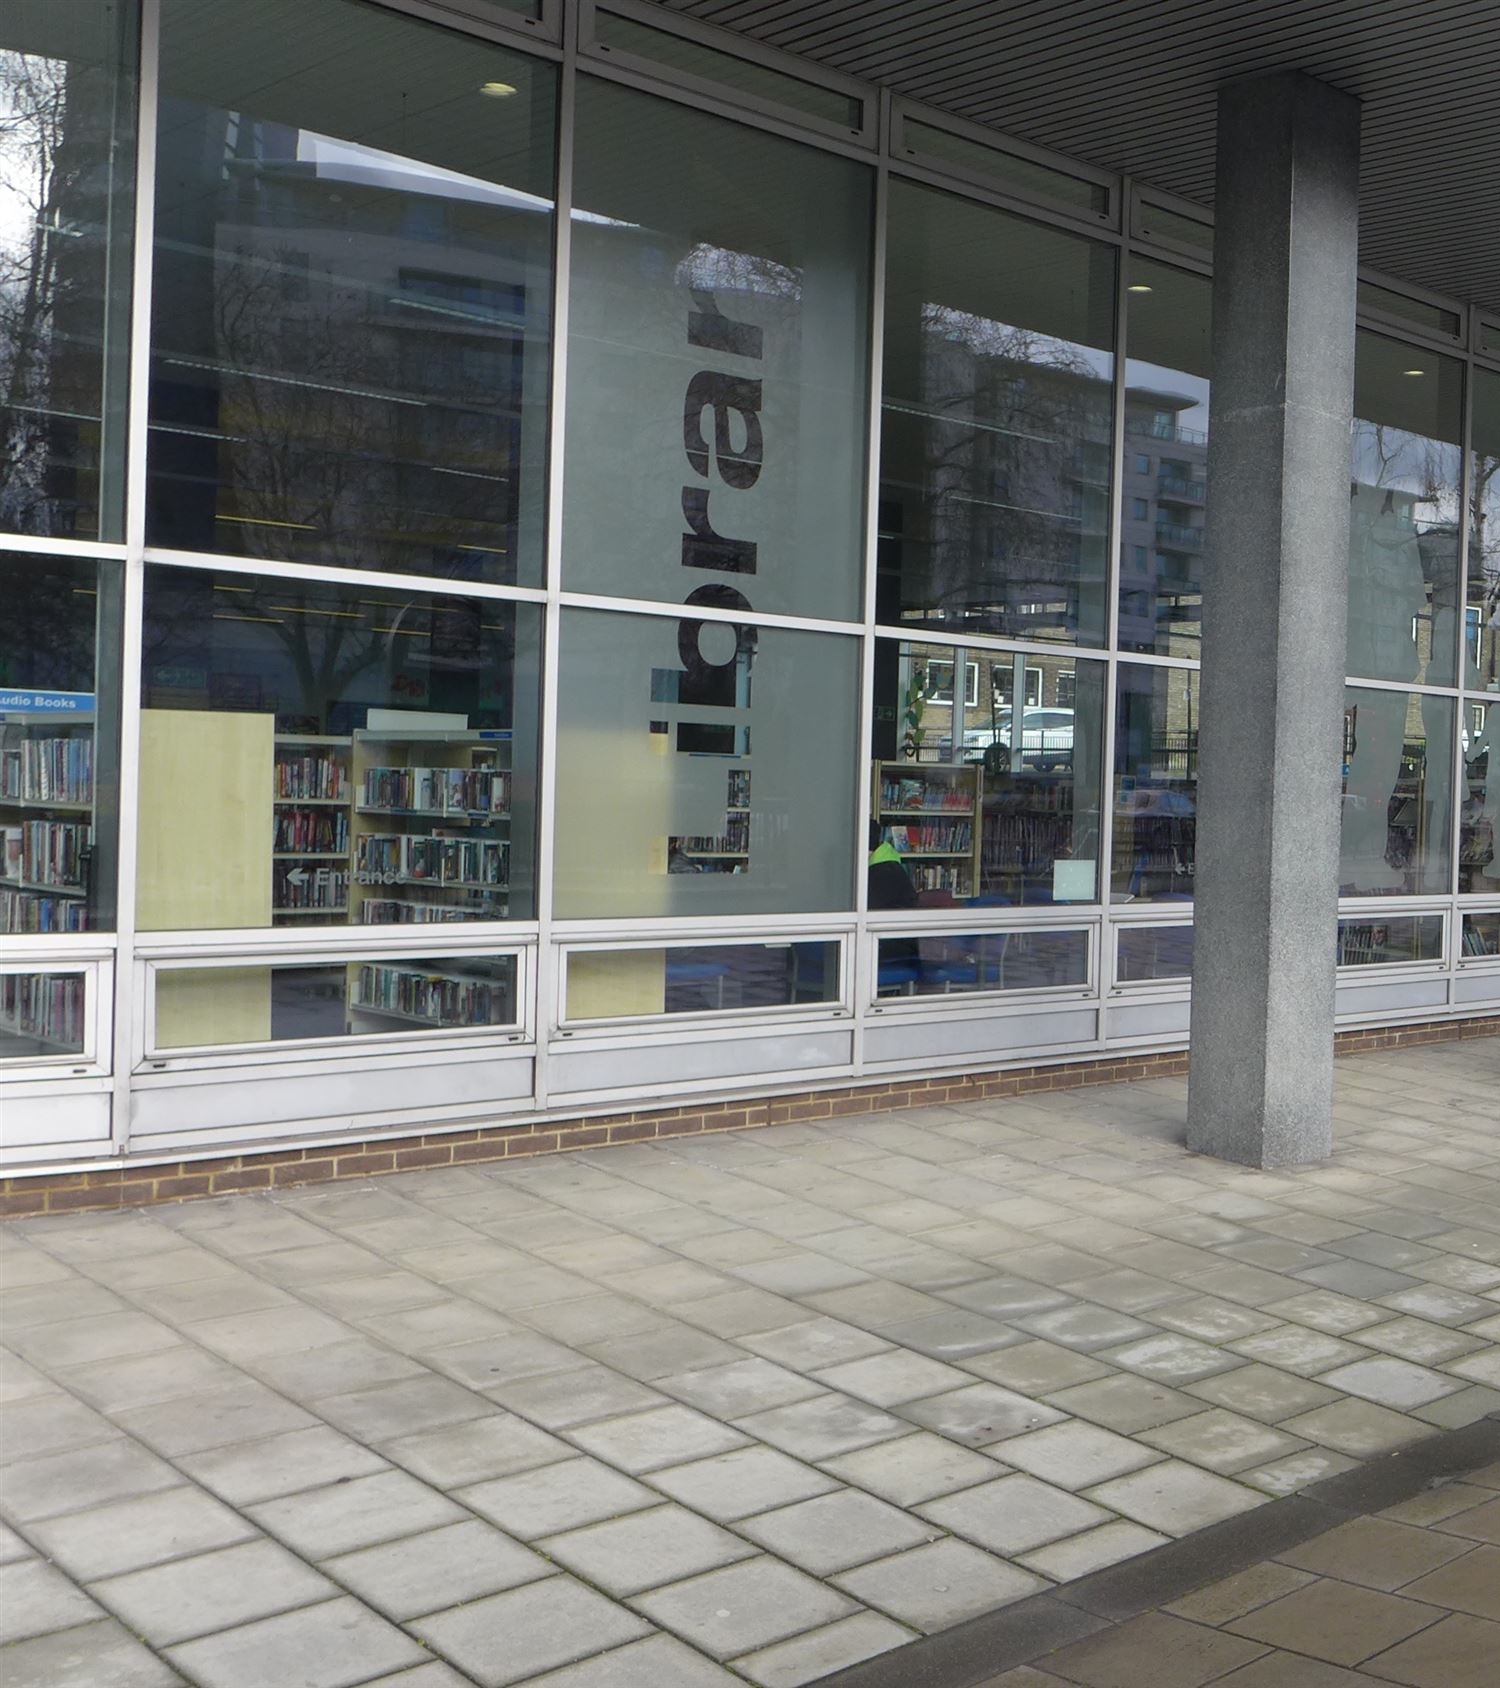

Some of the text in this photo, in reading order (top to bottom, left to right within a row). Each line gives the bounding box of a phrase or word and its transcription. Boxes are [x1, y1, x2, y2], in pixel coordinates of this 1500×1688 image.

[649, 285, 764, 875] Librar
[34, 696, 76, 708] Books
[315, 866, 407, 886] Entrance
